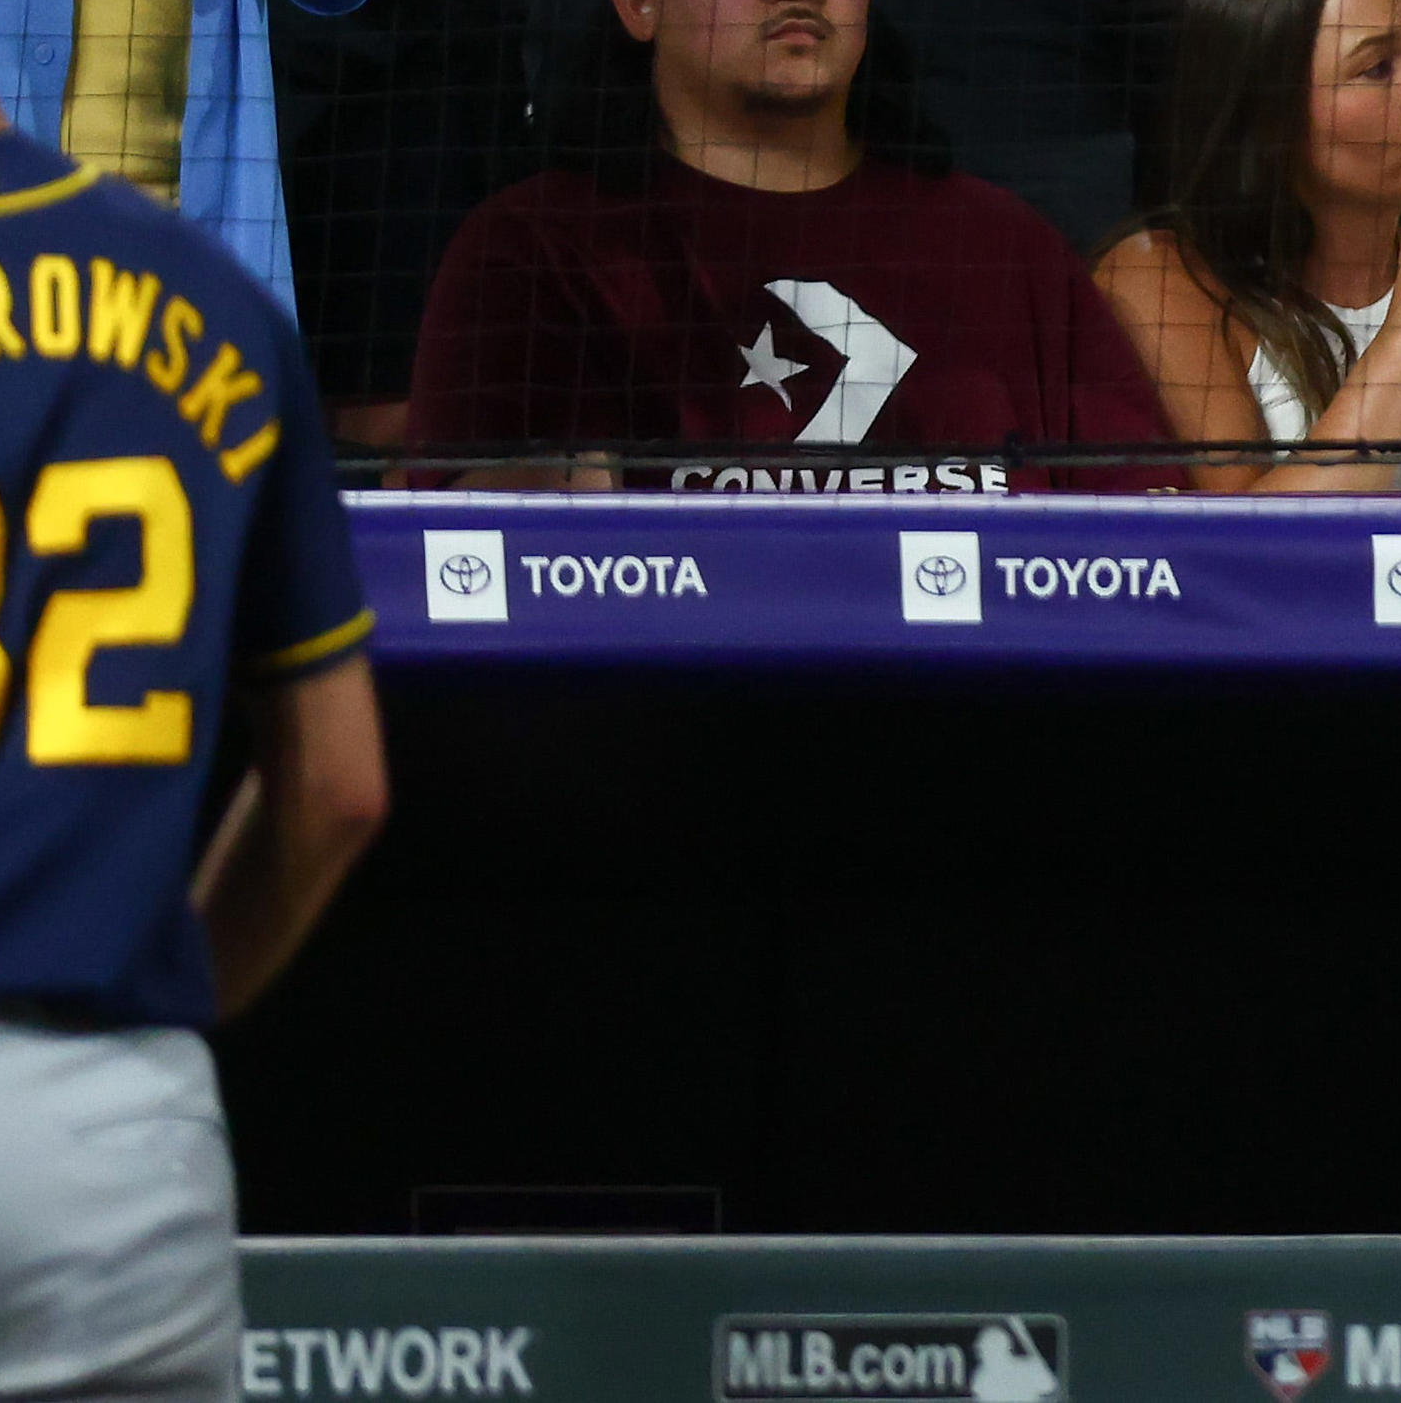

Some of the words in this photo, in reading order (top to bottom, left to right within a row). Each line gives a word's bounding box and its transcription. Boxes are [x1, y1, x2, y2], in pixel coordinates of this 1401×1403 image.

[670, 456, 1010, 494] CONVERSE
[520, 555, 709, 598] TOYOTA
[995, 556, 1182, 600] TOYOTA
[241, 1326, 534, 1394] ETWORK
[727, 1330, 967, 1390] MLB.com
